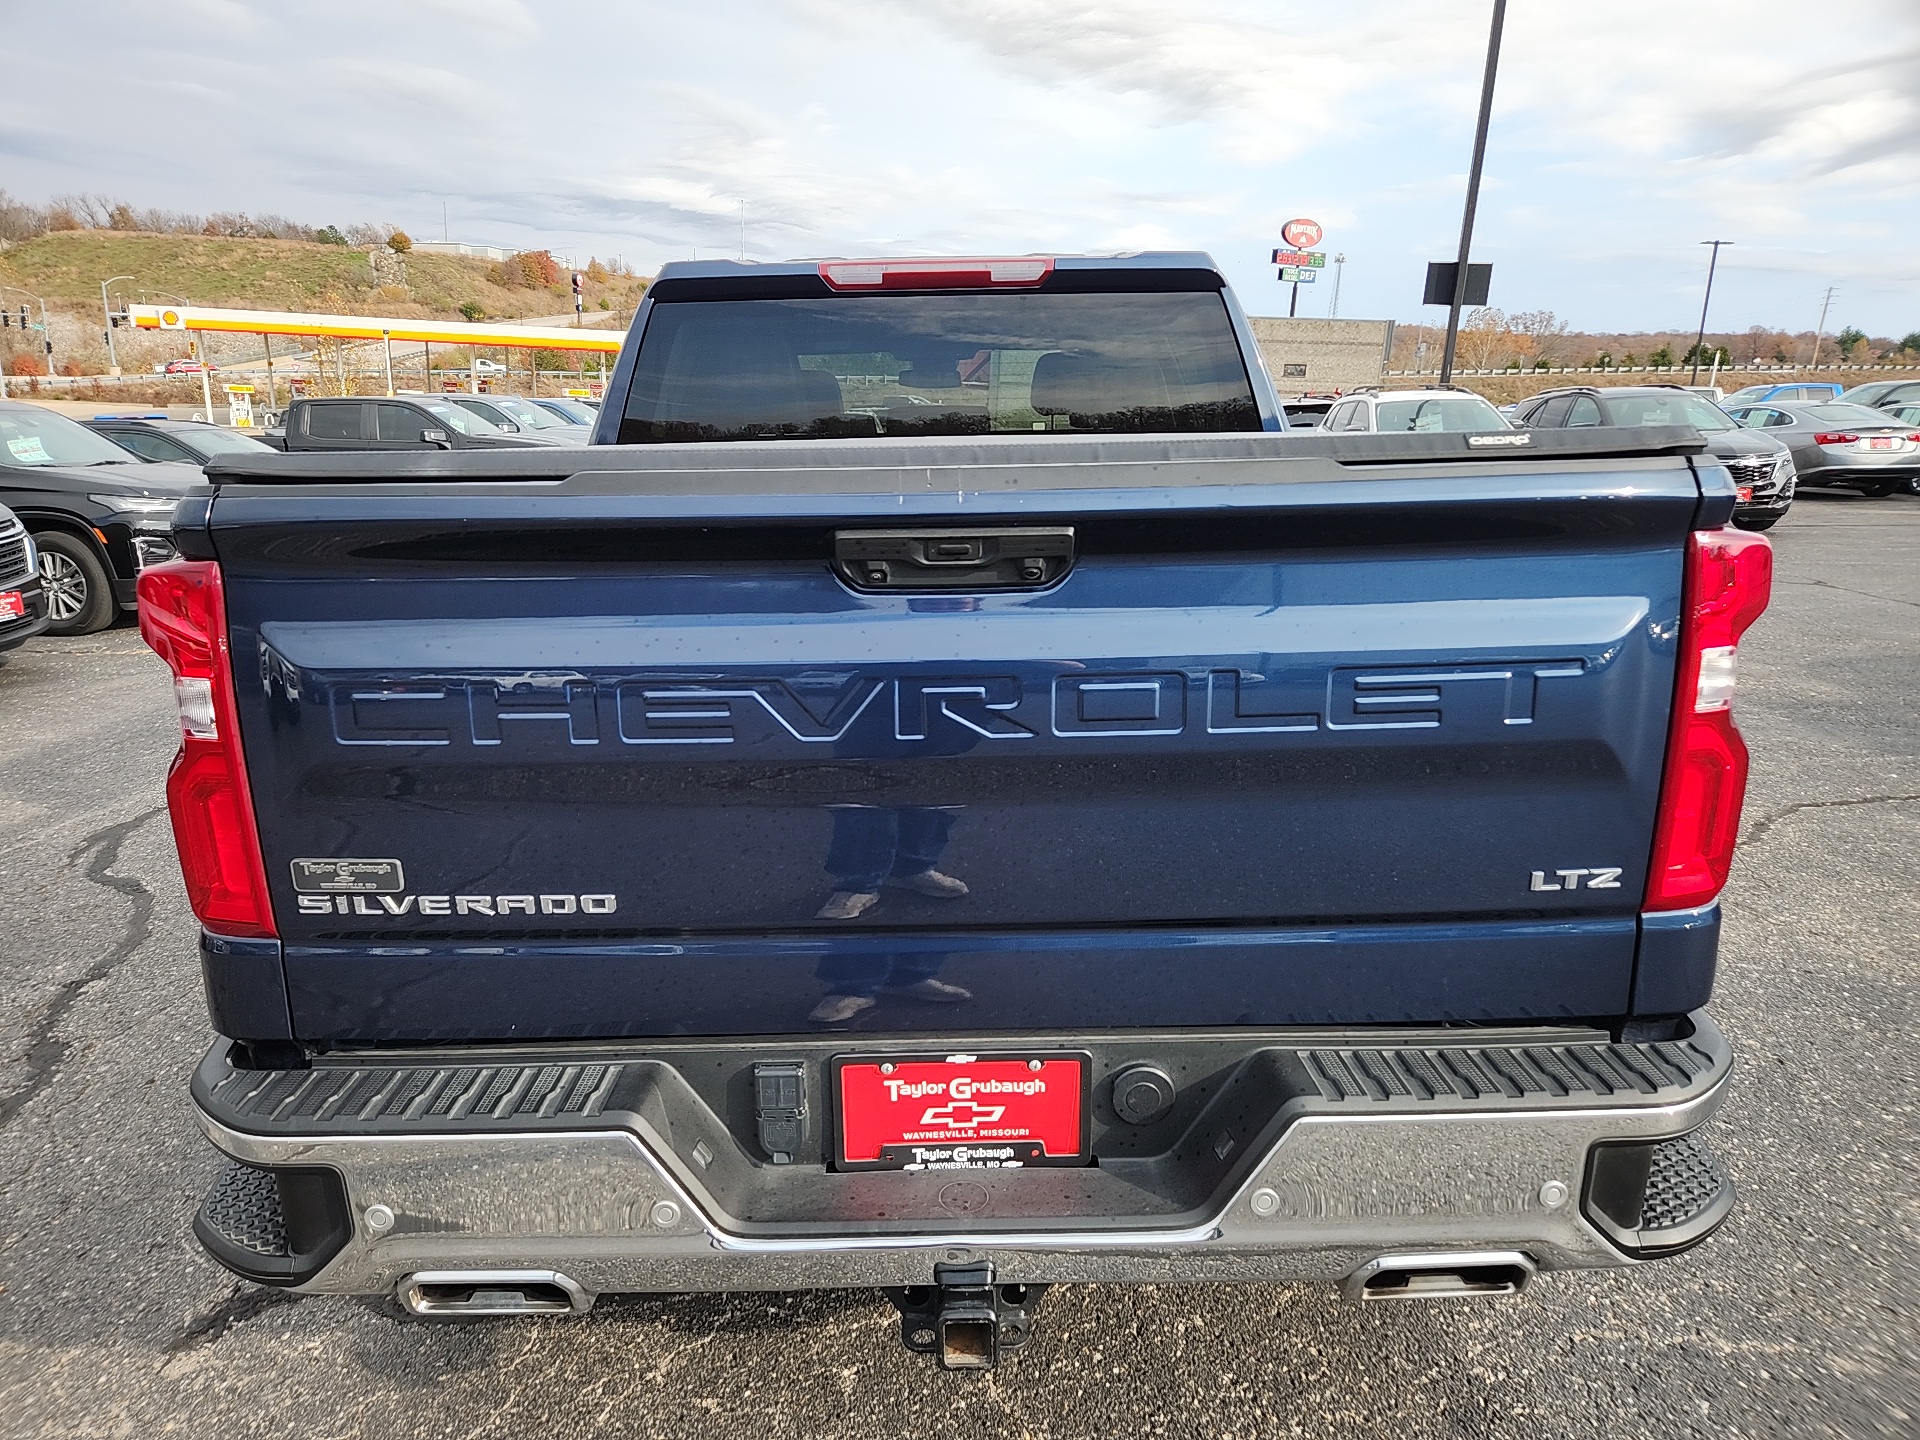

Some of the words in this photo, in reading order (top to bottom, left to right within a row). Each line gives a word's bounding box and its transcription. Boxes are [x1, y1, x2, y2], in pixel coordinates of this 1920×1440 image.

[1300, 270, 1316, 280] DEF
[329, 656, 1587, 746] CHEVROLET
[299, 862, 336, 876] Taylor
[336, 862, 392, 876] Grubaugh
[1530, 867, 1622, 892] LTZ
[297, 894, 618, 916] SILVERADO
[883, 1079, 947, 1102] Taylor
[949, 1077, 1046, 1099] Grubaugh
[903, 1128, 977, 1141] WAYNESVILLE,
[980, 1127, 1030, 1138] MISSOURI
[911, 1147, 952, 1163] Taylor
[953, 1146, 1015, 1162] Grubaugh
[986, 1160, 1000, 1169] MO
